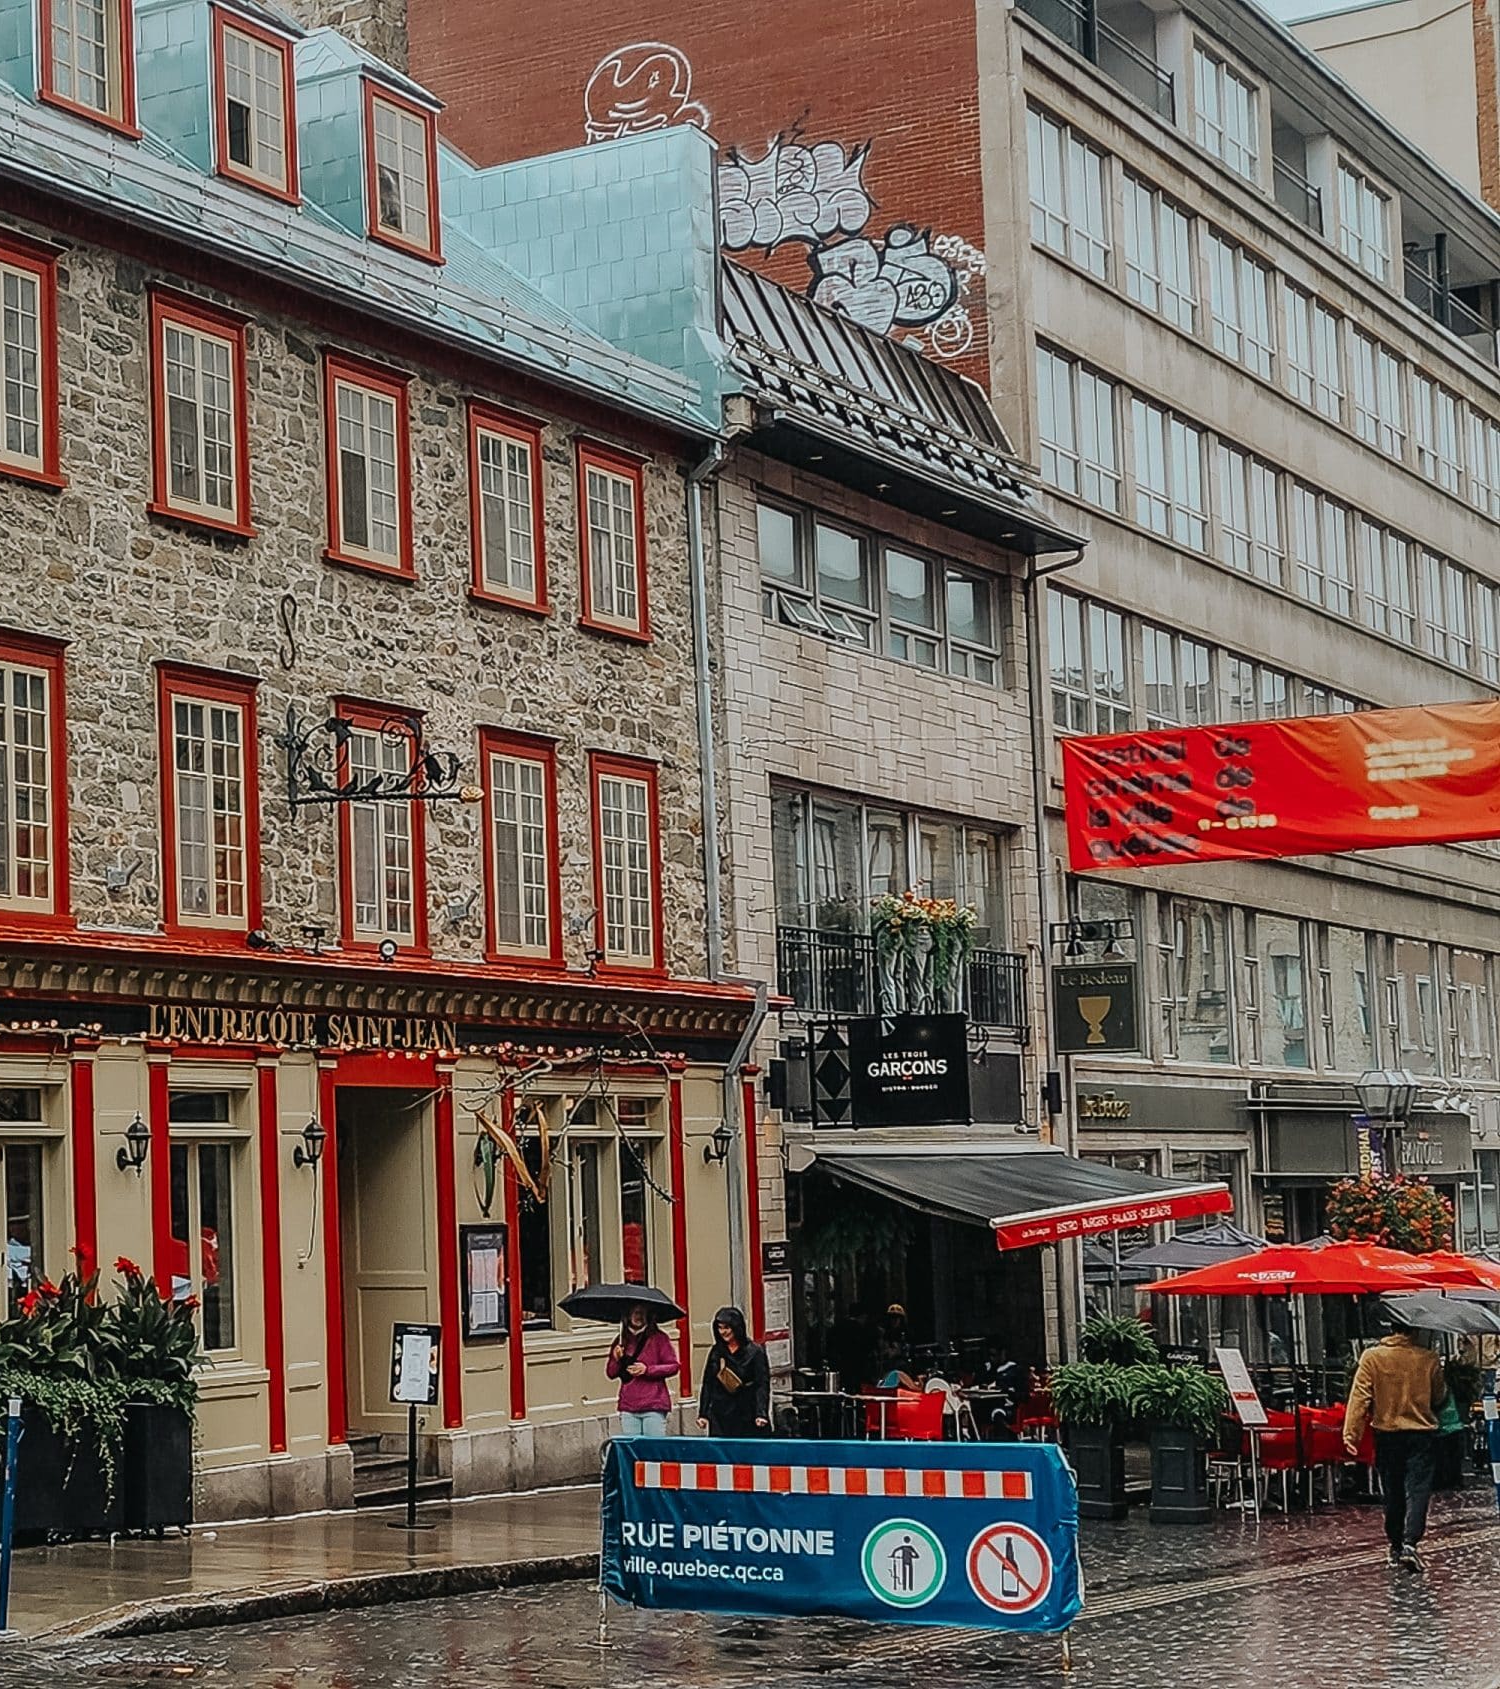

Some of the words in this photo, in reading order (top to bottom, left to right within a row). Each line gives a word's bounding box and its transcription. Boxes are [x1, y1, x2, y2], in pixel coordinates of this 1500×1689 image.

[149, 1003, 317, 1044] L'ENTRECÔTE
[328, 1014, 457, 1051] SAINT-JEAN
[621, 1521, 675, 1548] RUE
[683, 1520, 835, 1556] PIÉTONNE
[624, 1556, 785, 1584] ville.quebec.qc.ca
